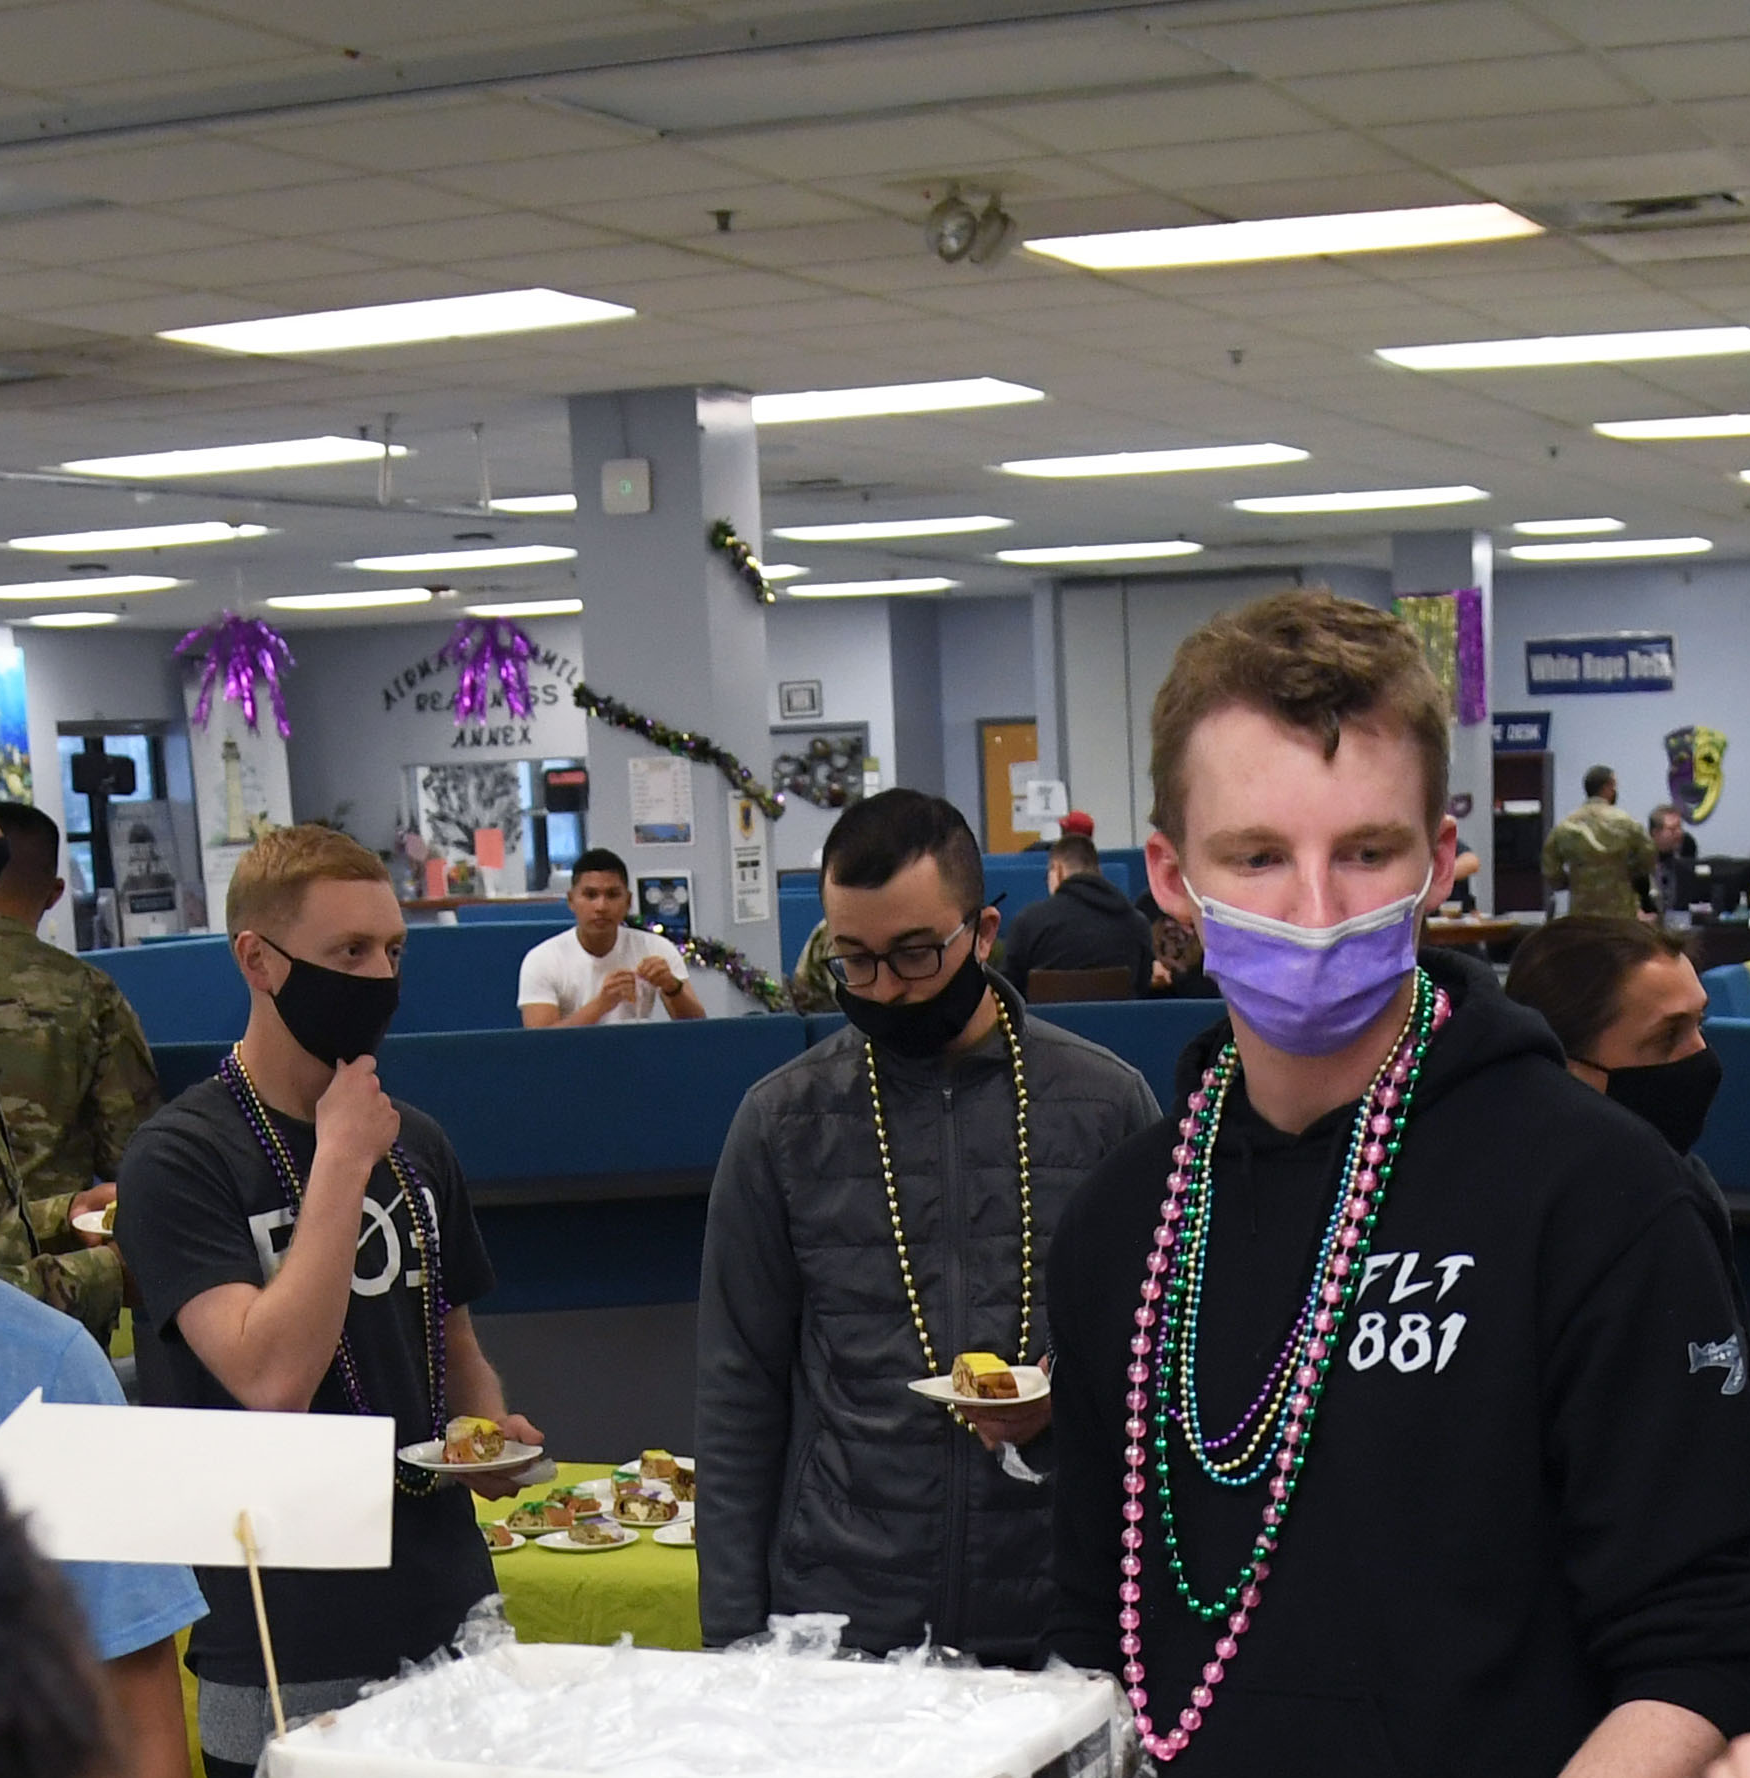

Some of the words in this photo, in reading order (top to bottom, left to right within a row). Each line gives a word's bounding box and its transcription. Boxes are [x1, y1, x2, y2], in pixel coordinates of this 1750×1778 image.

[451, 724, 532, 748] ANNEX
[1355, 1252, 1475, 1306] FLT
[1347, 1311, 1468, 1375] 881
